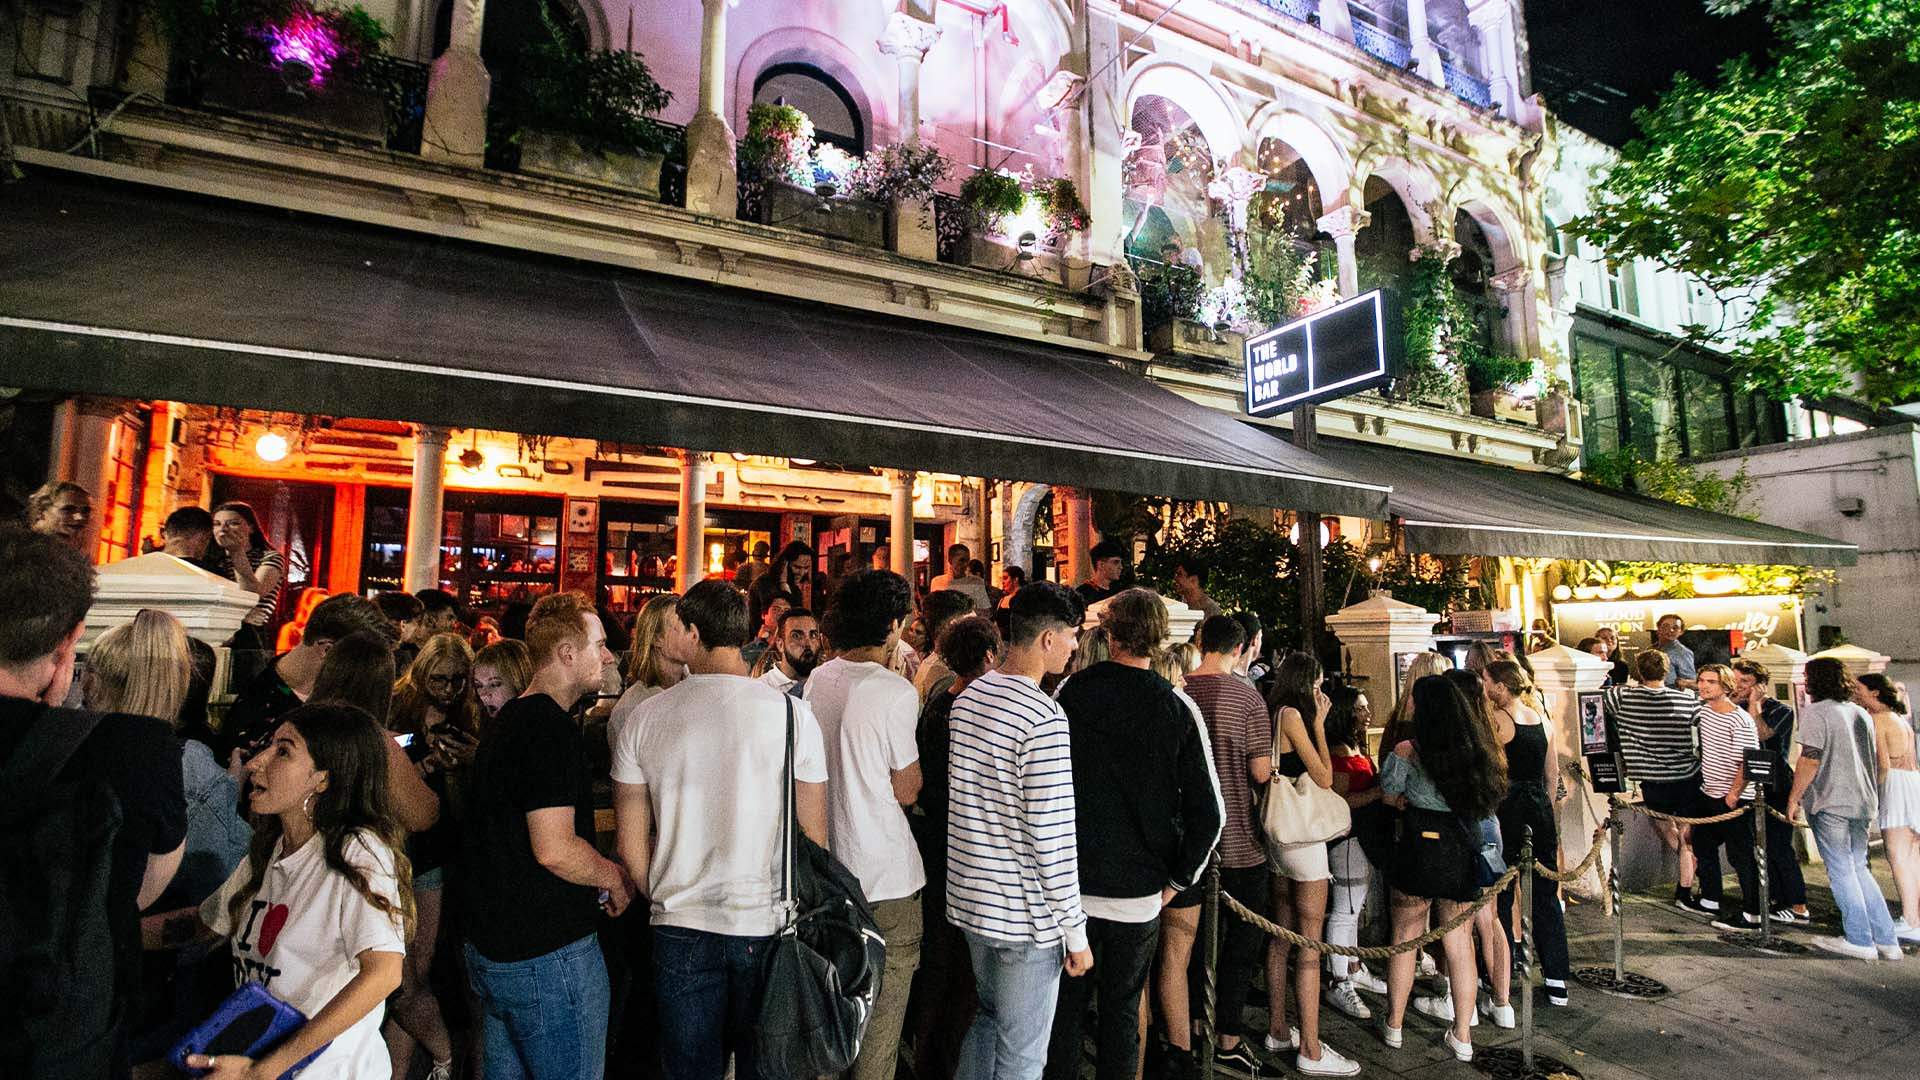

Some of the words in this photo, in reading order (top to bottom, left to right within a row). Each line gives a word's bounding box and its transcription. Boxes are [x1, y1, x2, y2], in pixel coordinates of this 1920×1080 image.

[1253, 340, 1277, 363] THE
[1254, 354, 1298, 382] WORLD
[1255, 380, 1279, 402] BAR
[239, 901, 267, 950] I
